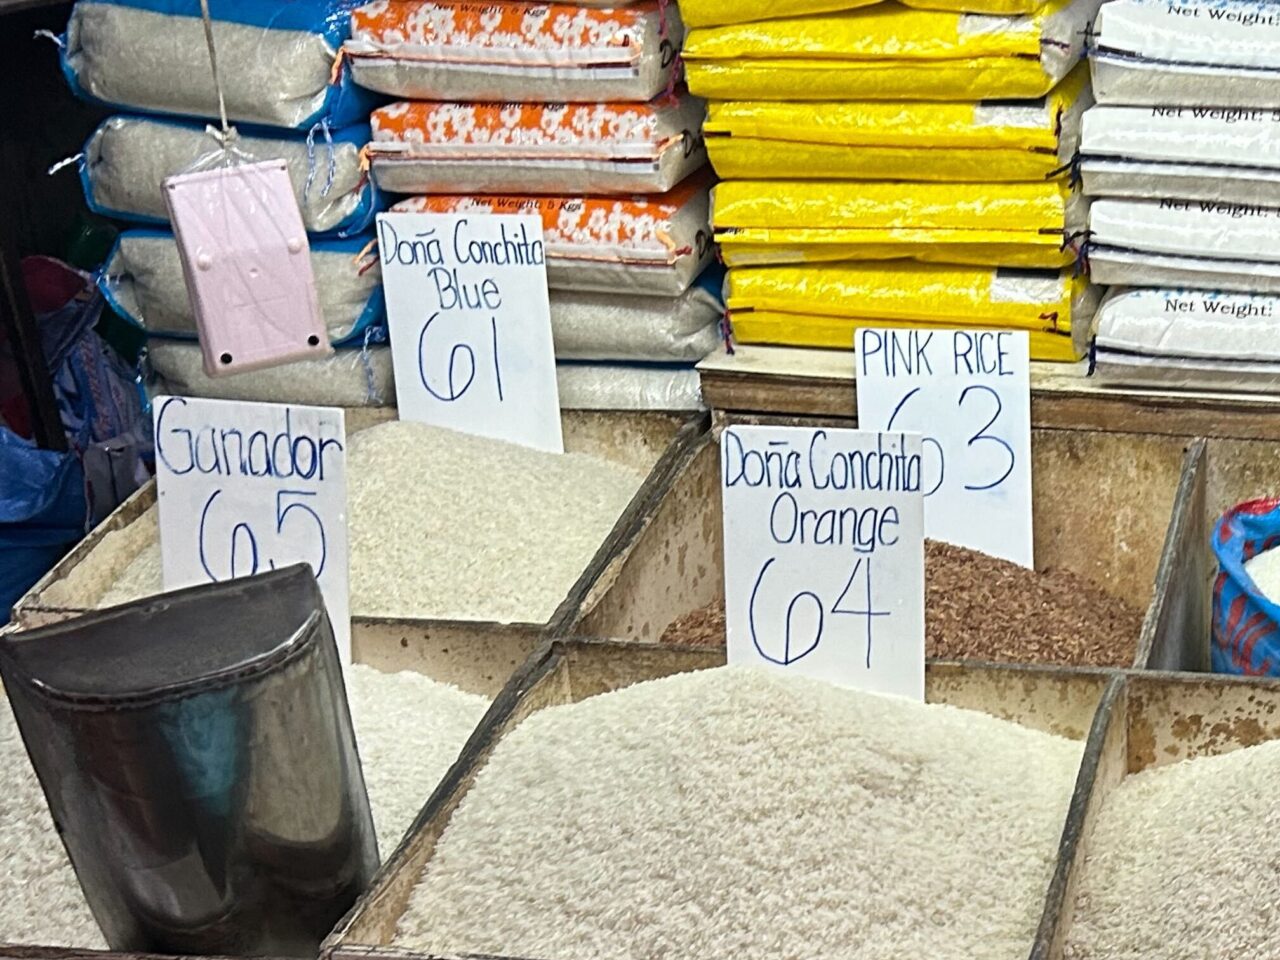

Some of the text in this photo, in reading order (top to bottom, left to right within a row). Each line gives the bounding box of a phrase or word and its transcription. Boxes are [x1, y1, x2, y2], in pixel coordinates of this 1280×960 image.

[1167, 5, 1199, 17] Net
[1209, 9, 1280, 26] Weight:
[1151, 104, 1183, 118] Net
[1159, 198, 1190, 211] Net
[453, 219, 544, 265] Conchita
[427, 267, 501, 310] Blue
[1164, 299, 1195, 312] Net
[1202, 301, 1272, 317] Weight:
[418, 311, 503, 401] 61
[862, 330, 1015, 377] PINK RICE
[808, 430, 922, 491] Conchita
[199, 488, 326, 582] 65
[770, 492, 899, 553] Orange
[749, 556, 891, 669] 64
